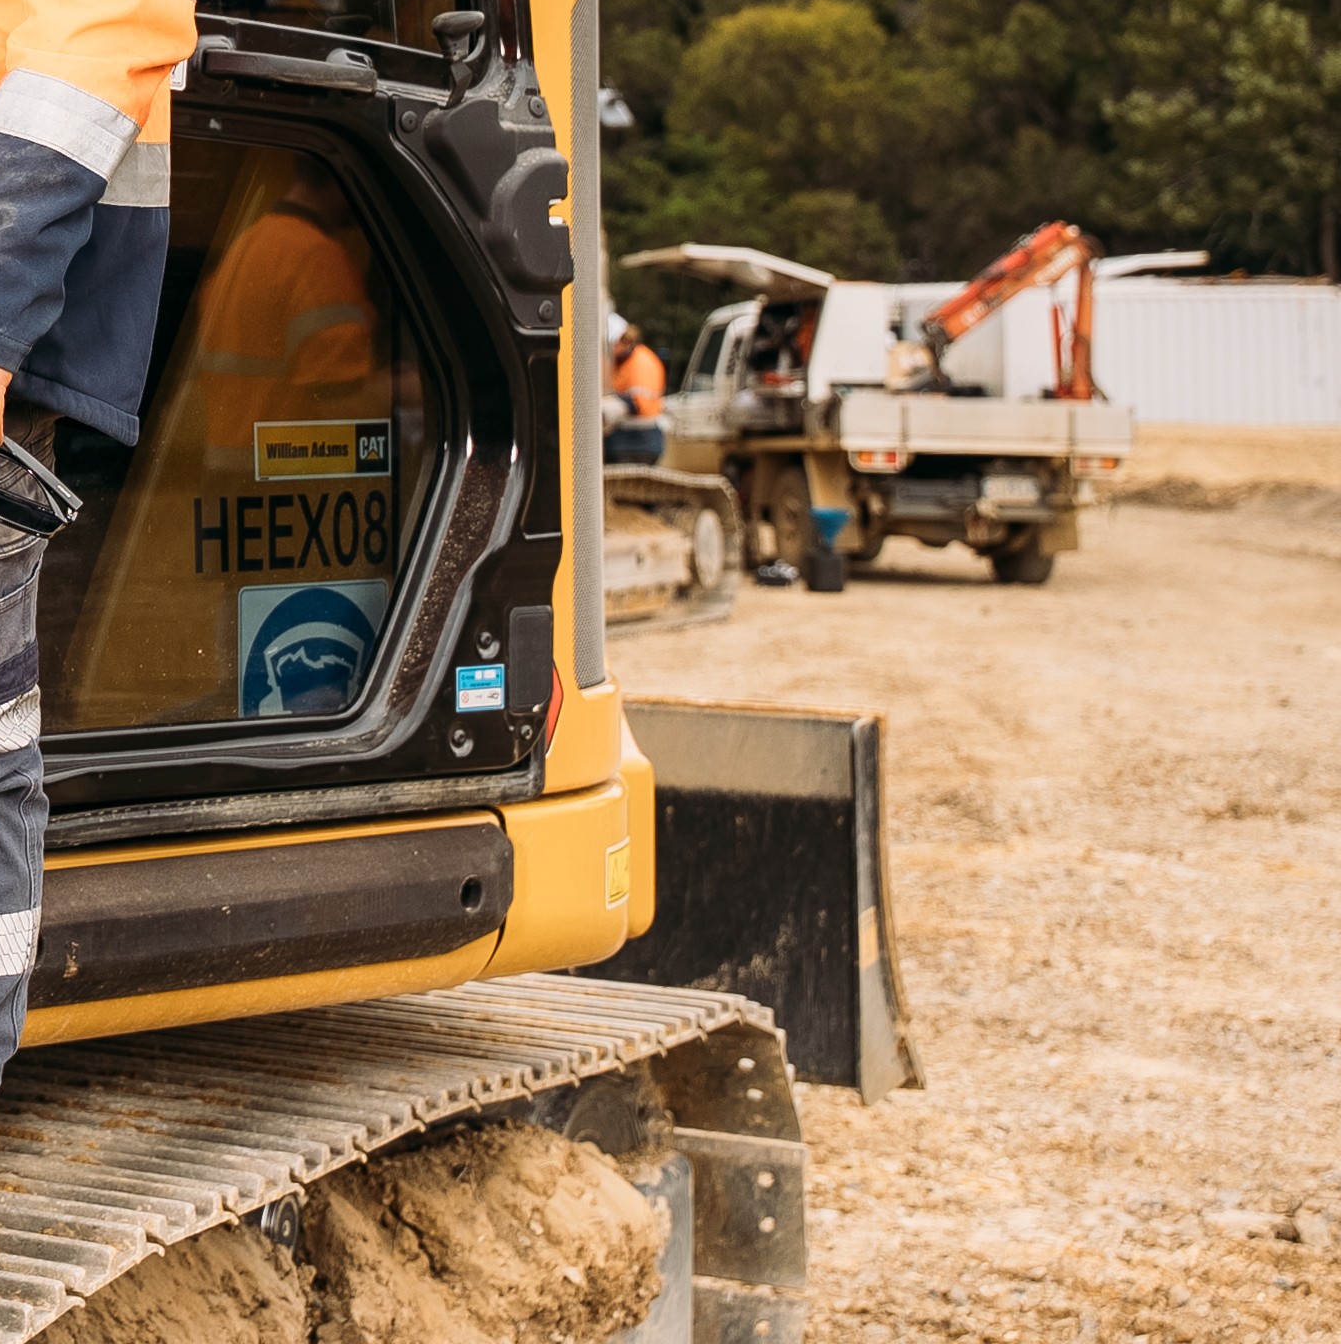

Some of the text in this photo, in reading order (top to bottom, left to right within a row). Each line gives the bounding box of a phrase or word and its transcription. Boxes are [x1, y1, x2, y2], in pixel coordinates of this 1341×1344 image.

[265, 436, 386, 460] William Adams CAT
[194, 490, 388, 574] HEEX08
